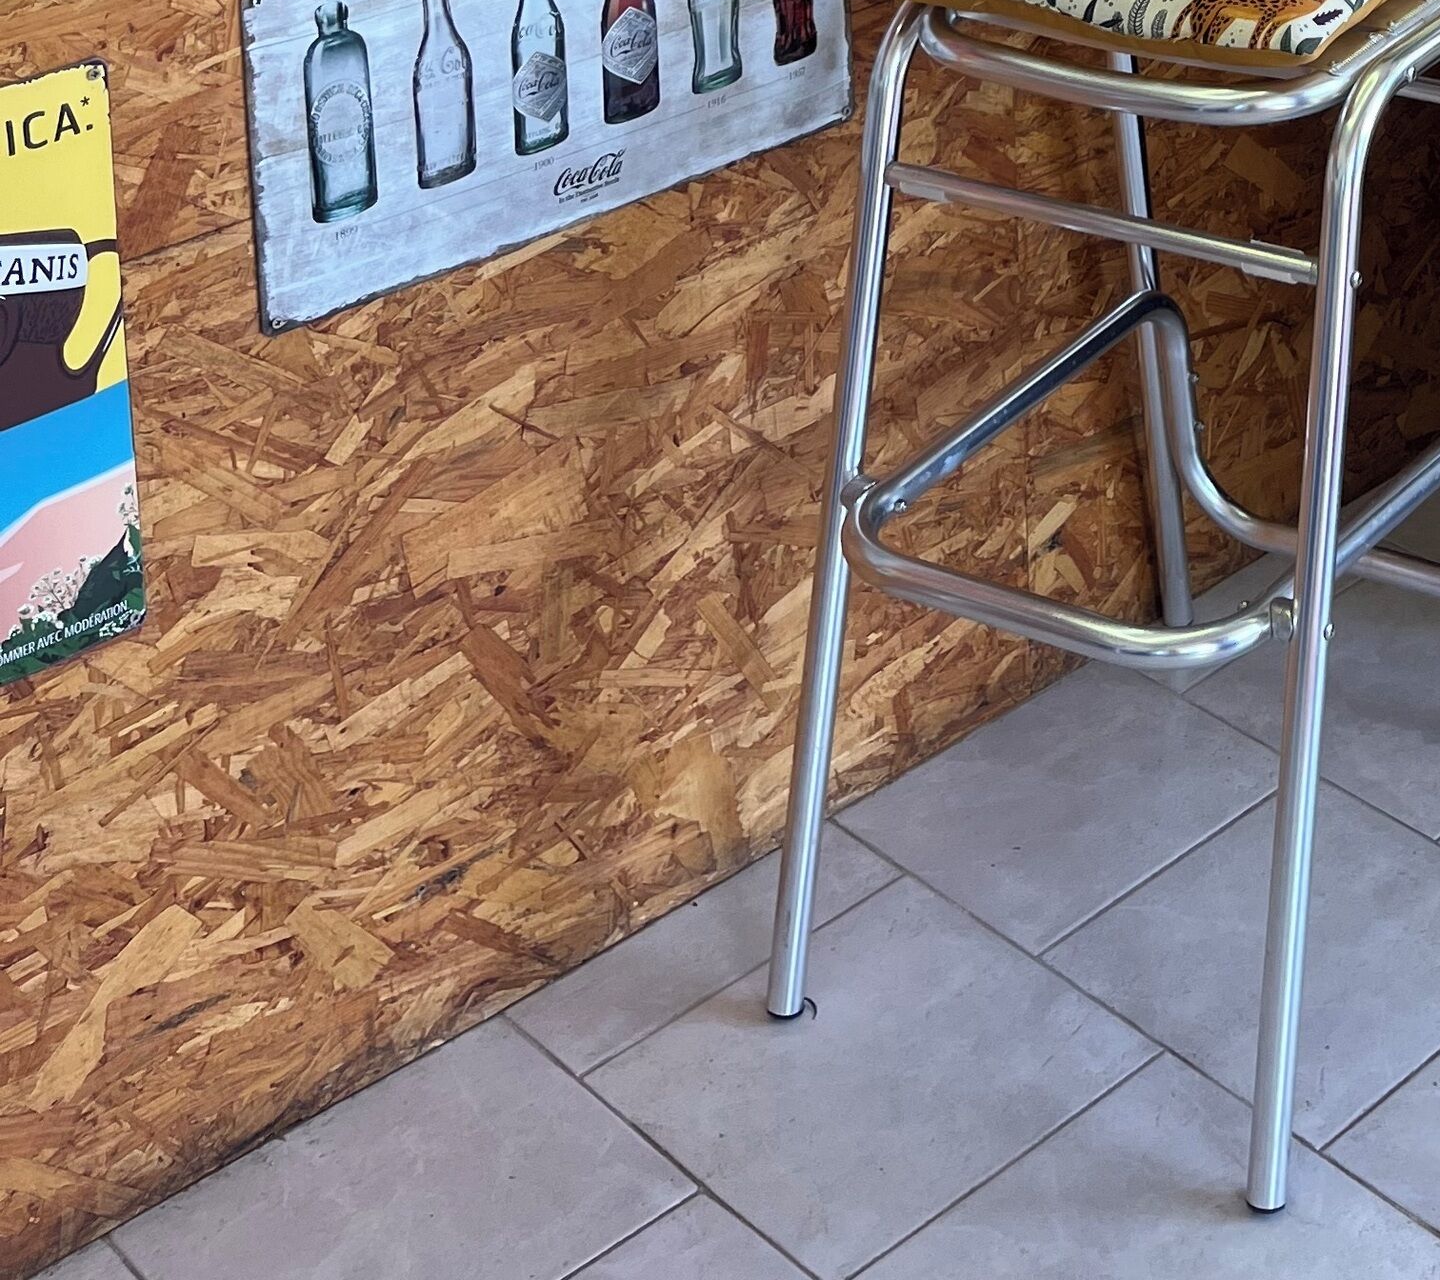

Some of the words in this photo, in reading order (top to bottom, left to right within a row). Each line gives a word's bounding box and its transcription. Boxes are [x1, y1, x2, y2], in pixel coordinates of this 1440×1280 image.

[0, 253, 79, 287] ANIS
[36, 629, 63, 651] AVEC
[64, 599, 129, 639] MODÉRATION
